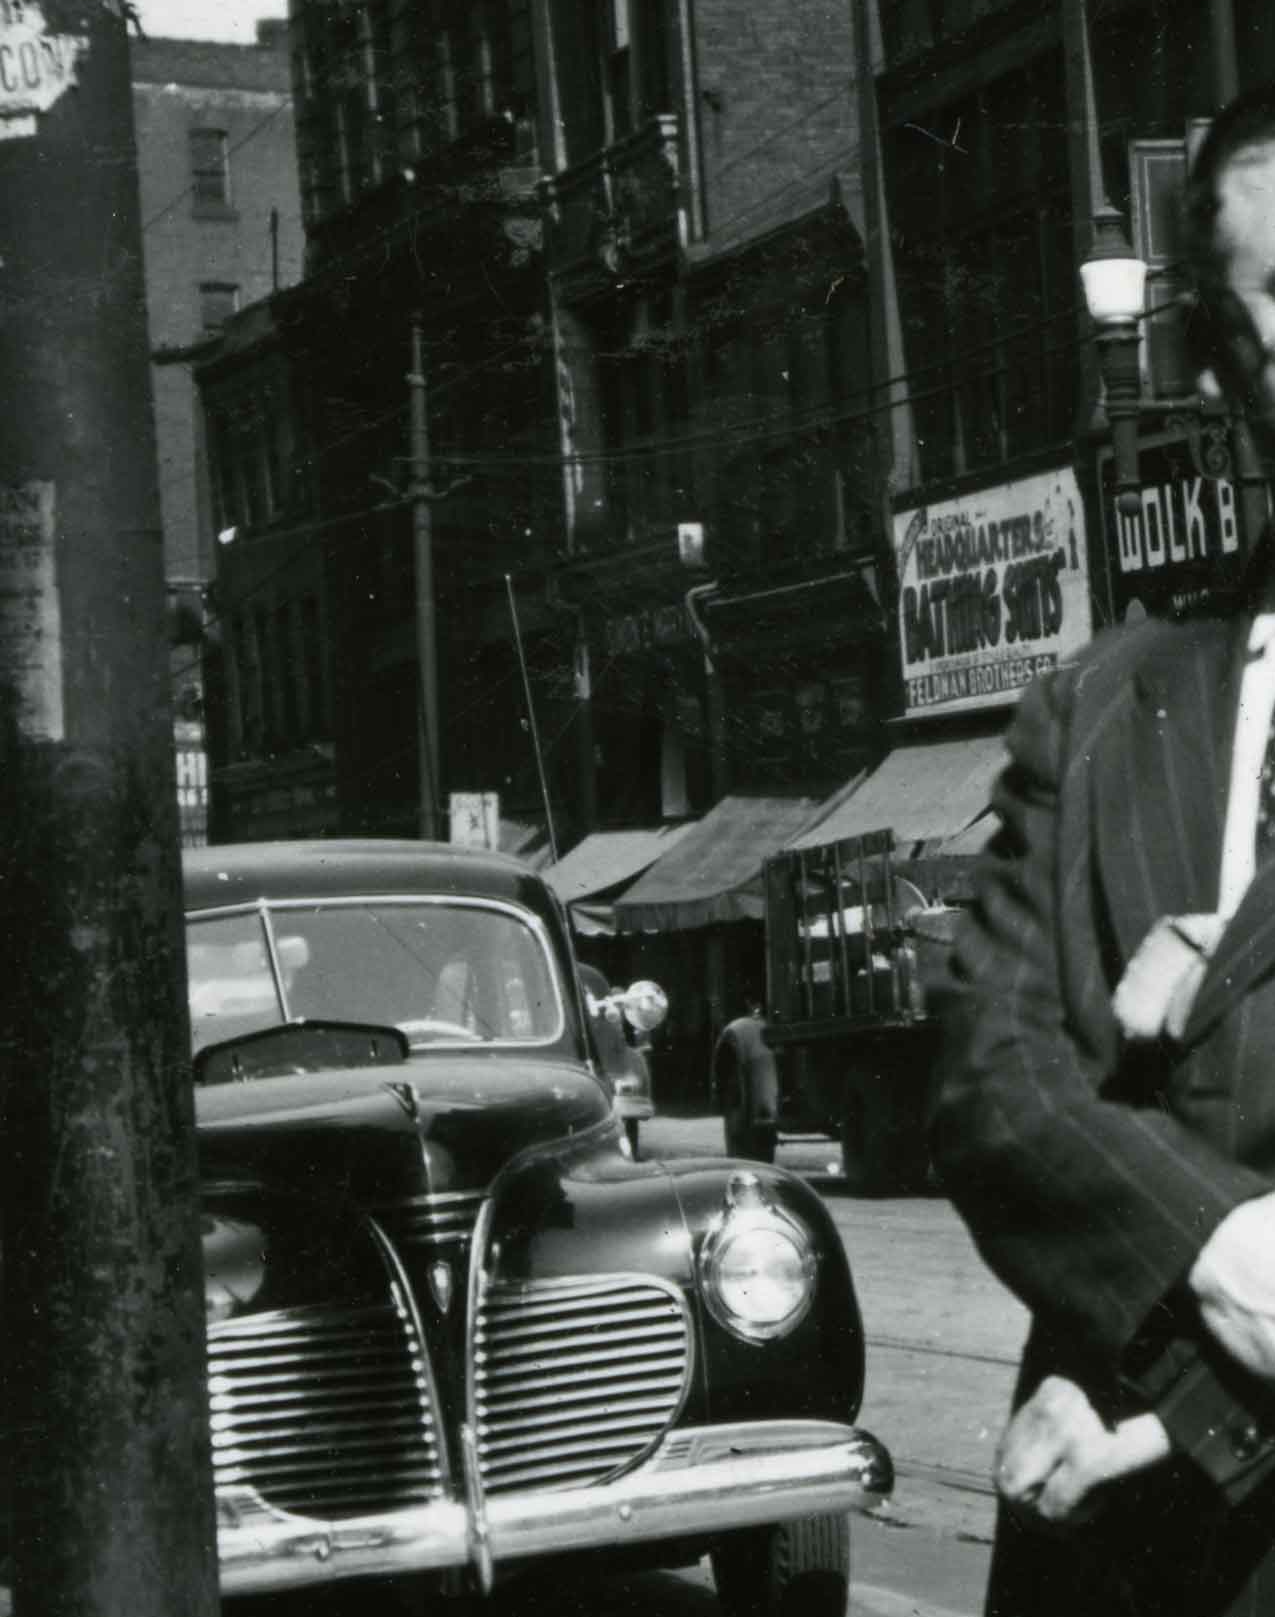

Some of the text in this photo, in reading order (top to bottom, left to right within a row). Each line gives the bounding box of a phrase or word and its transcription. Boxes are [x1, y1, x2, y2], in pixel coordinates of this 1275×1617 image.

[915, 511, 1046, 580] HEADQUARTERS
[1114, 476, 1208, 574] WOLK
[909, 671, 968, 707] FELDMAN
[968, 660, 1034, 695] BROTHERS
